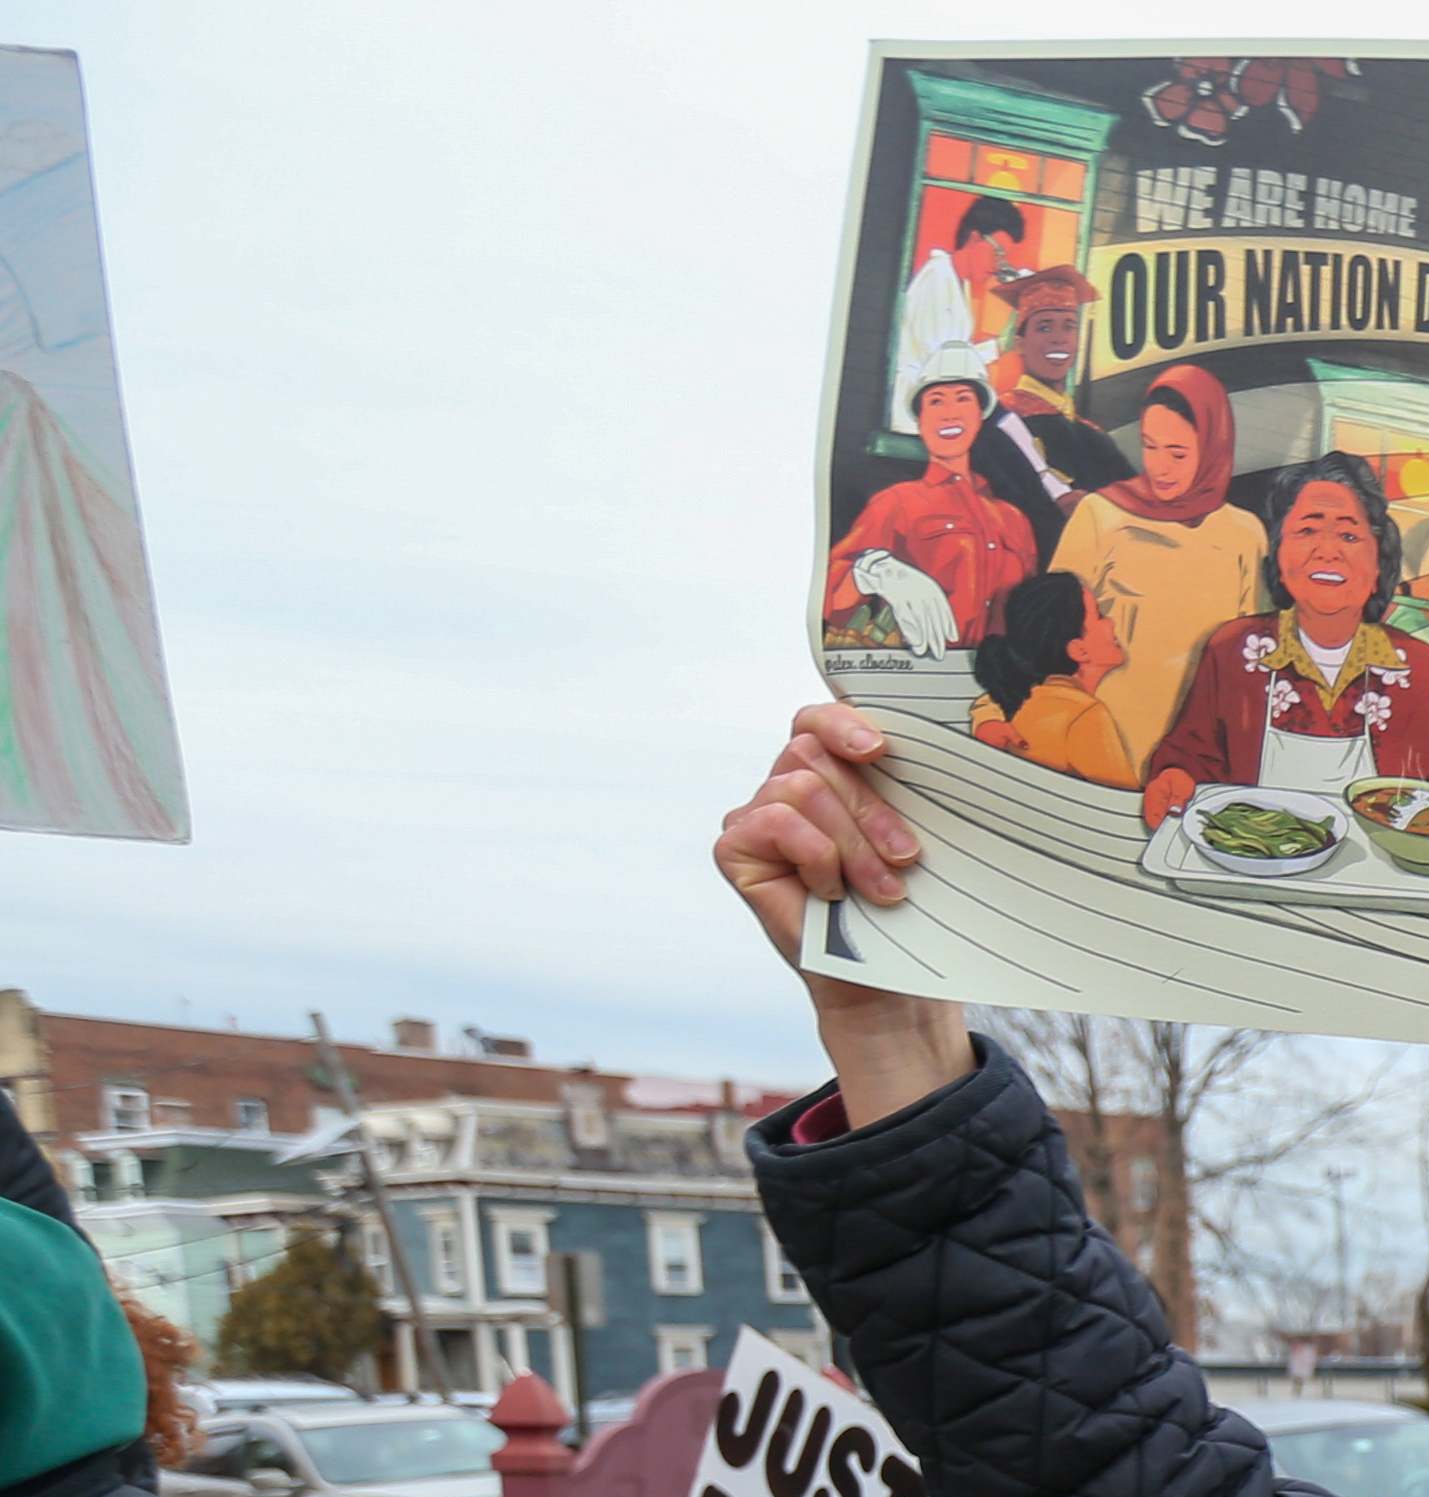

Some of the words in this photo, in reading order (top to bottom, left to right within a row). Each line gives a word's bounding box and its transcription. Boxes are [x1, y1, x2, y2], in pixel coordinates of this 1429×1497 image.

[1136, 166, 1218, 233] WE
[1221, 167, 1308, 229] ARE
[1313, 177, 1418, 239] HOME
[1110, 249, 1228, 361] OUR
[1243, 248, 1403, 338] NATION
